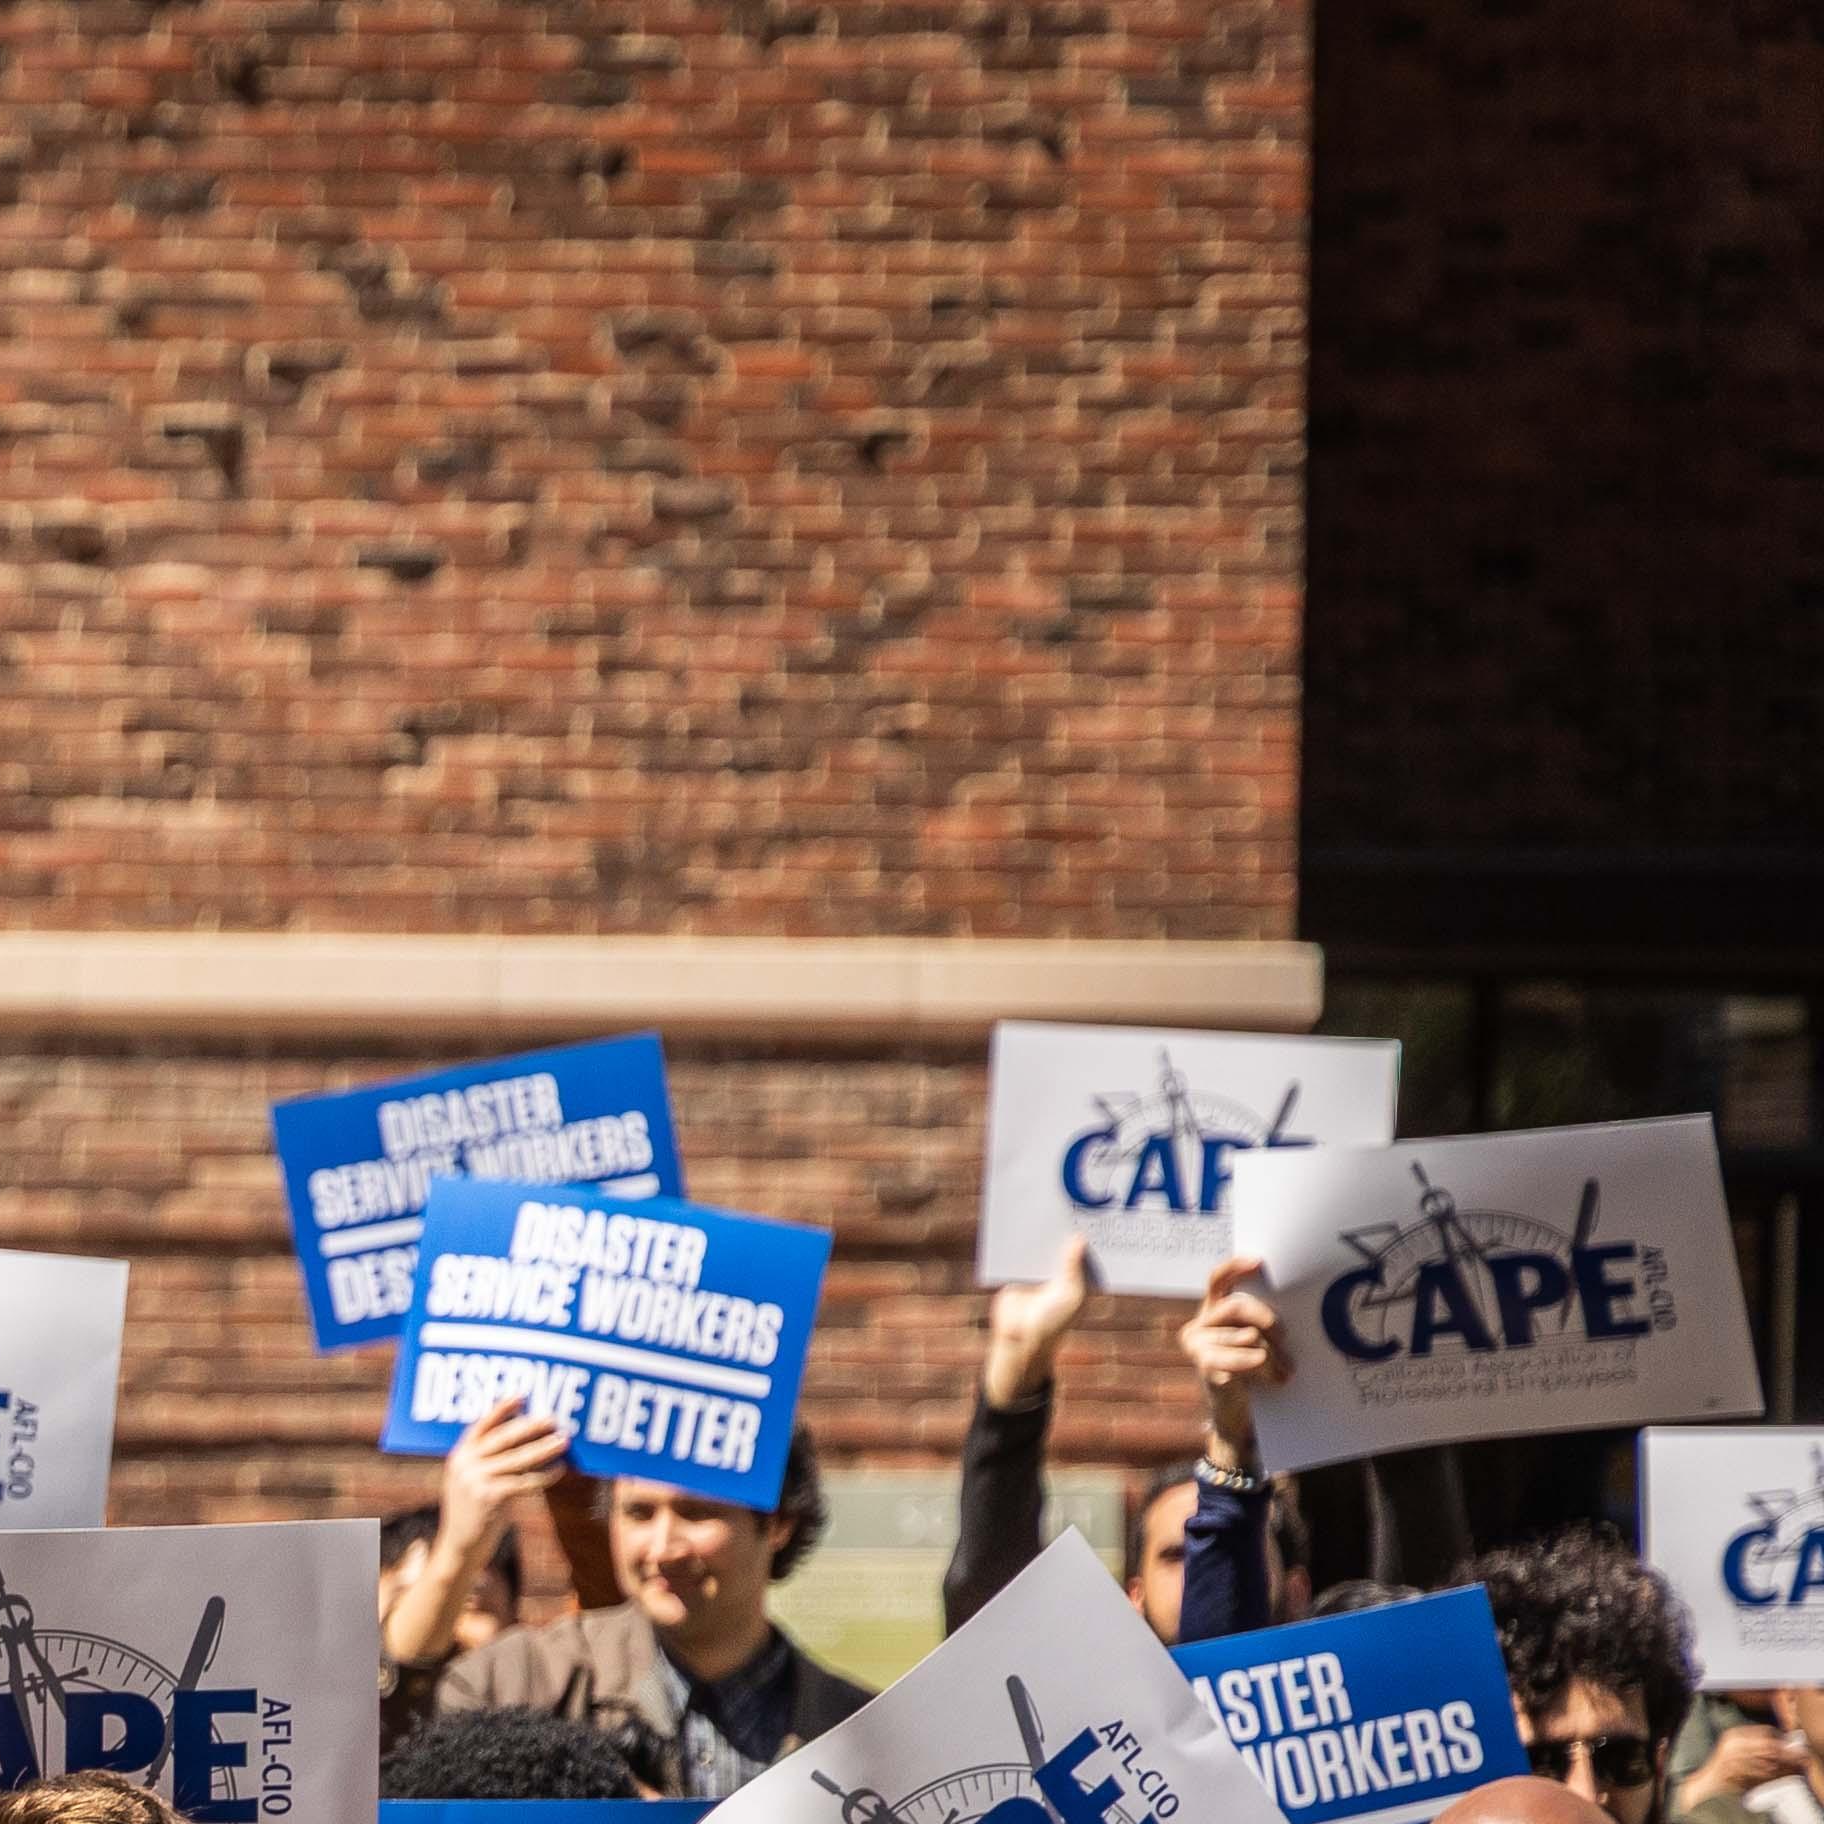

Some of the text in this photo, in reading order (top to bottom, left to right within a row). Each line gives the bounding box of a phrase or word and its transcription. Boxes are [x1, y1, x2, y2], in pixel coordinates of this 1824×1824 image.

[378, 1073, 562, 1159] DISASTER
[465, 1110, 654, 1185] WORKERS
[1062, 1123, 1316, 1215] CAP
[510, 1201, 708, 1288] DISASTER
[426, 1253, 576, 1328] SERVICE
[579, 1270, 784, 1367] WORKERS
[1321, 1241, 1651, 1361] CAPE
[7, 1398, 40, 1499] AFL-CIO
[410, 1351, 762, 1474] DESERVE BETTER
[1722, 1522, 1824, 1608] CA
[1193, 1652, 1352, 1743] ASTER
[260, 1698, 292, 1816] AFL-CIO
[1099, 1719, 1180, 1819] AFL-CIO
